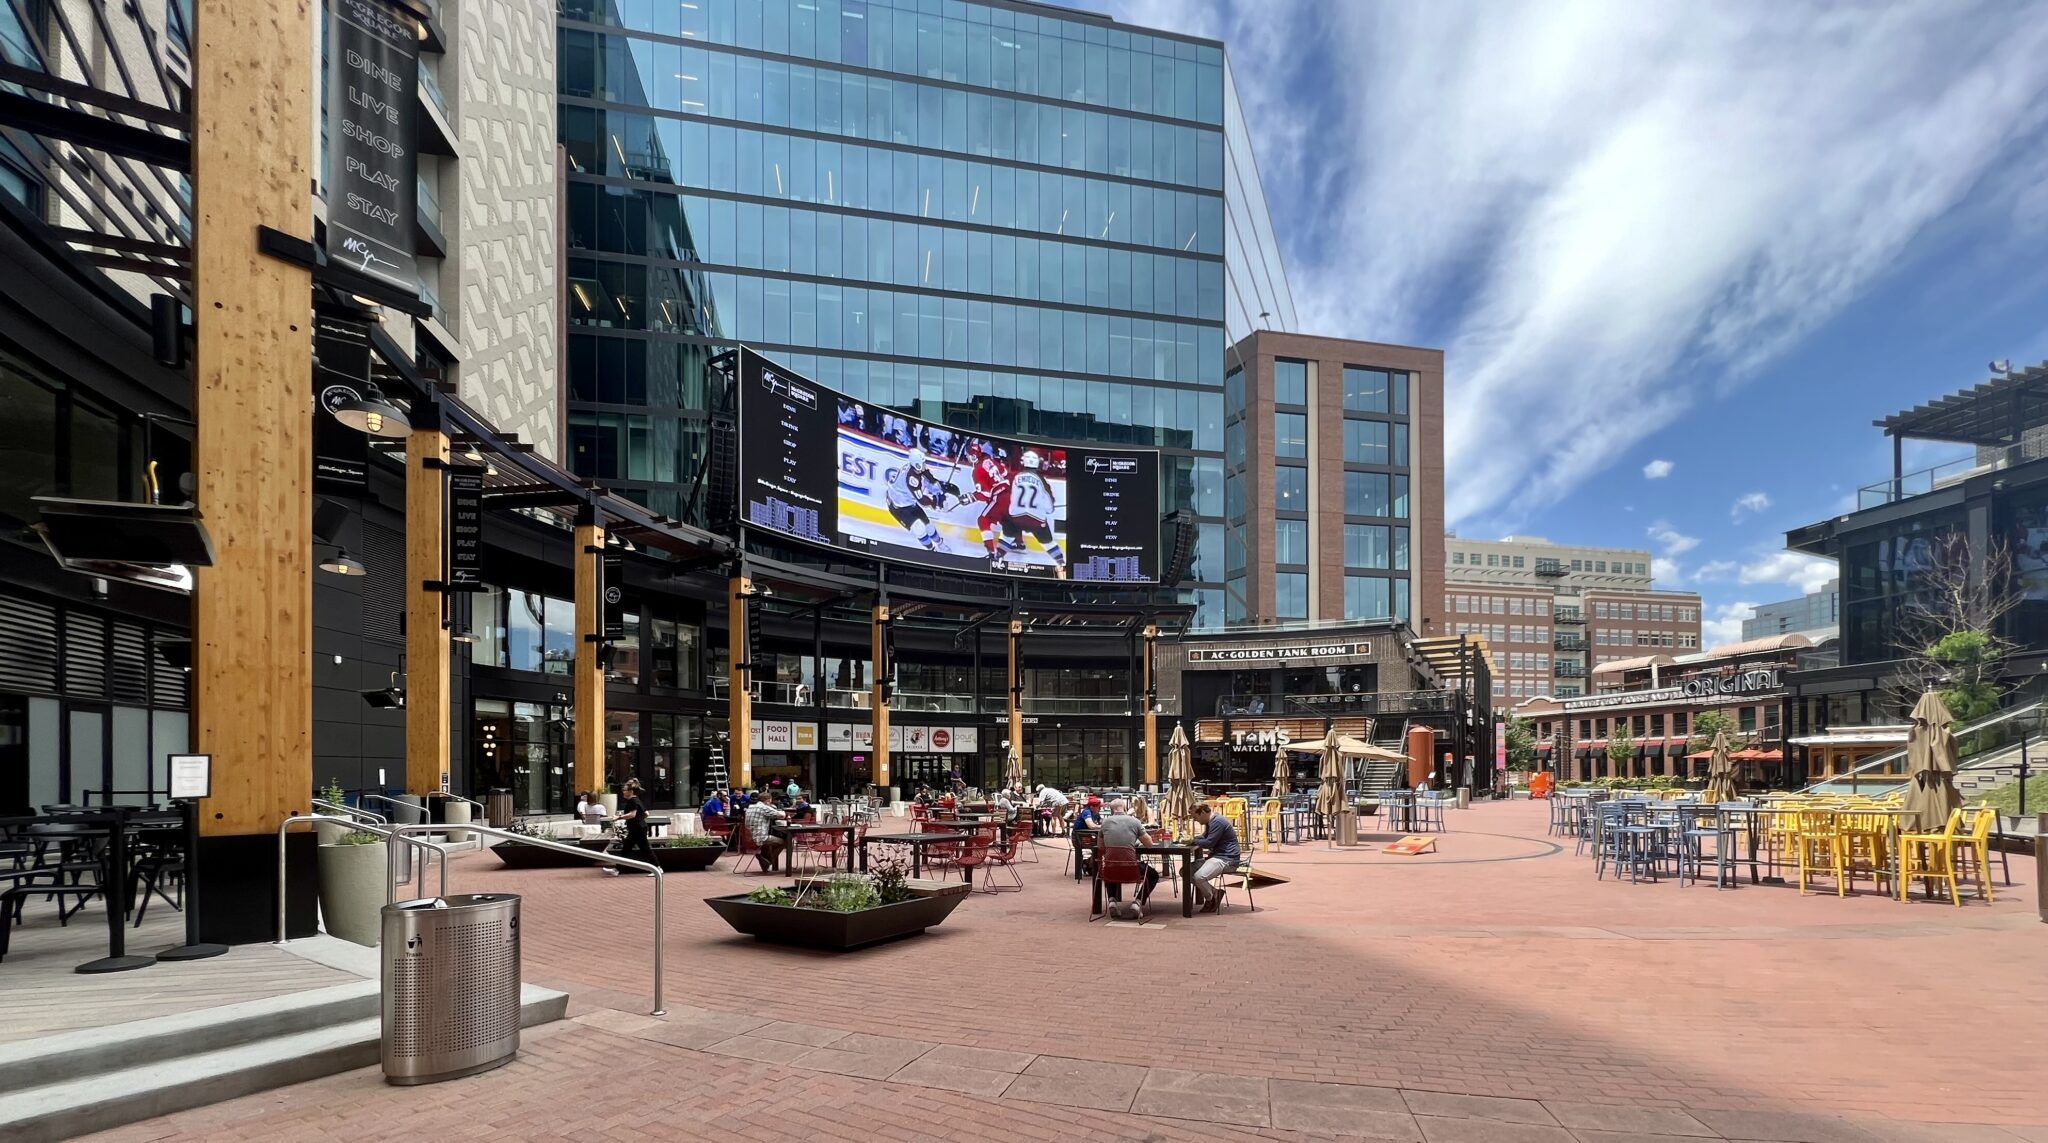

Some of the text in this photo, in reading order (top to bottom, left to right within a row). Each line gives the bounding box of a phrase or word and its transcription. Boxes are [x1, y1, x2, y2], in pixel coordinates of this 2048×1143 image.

[352, 9, 399, 40] SQUARE
[346, 48, 402, 92] DINE
[348, 85, 400, 126] LIVE
[342, 119, 405, 159] SHOP
[346, 155, 400, 193] PLAY
[346, 192, 399, 227] STAY
[783, 456, 797, 466] PLAY
[783, 475, 797, 484] STAY
[1017, 485, 1038, 509] 22
[457, 512, 477, 521] LIVE
[455, 525, 478, 534] SHOP
[456, 539, 477, 548] PLAY
[456, 553, 476, 561] STAY
[1278, 649, 1308, 657] TANK
[1311, 646, 1346, 656] ROOM
[1684, 670, 1784, 698] ORIGINAL
[767, 725, 788, 733] FOOD
